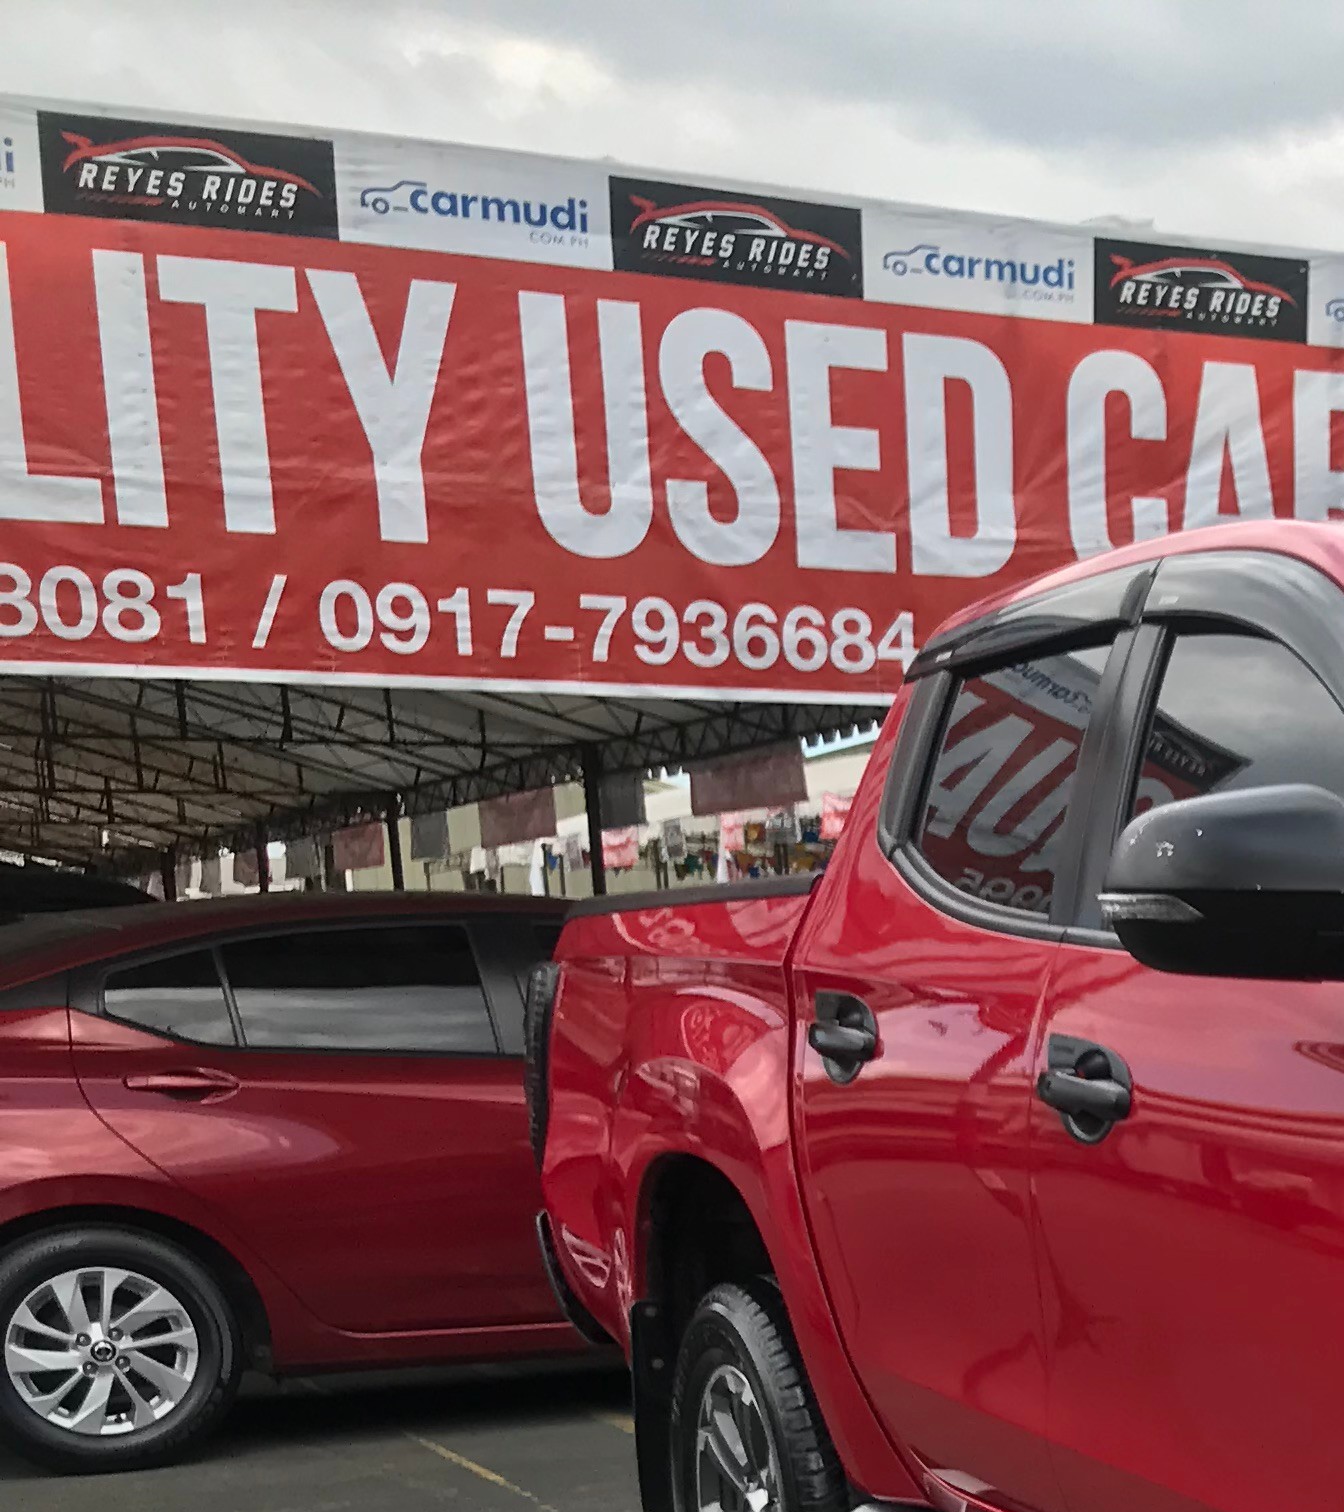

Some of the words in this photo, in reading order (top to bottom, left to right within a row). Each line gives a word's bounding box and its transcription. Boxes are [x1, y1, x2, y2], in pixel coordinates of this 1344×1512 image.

[78, 162, 186, 197] REYES
[202, 174, 299, 209] RIDES
[170, 198, 296, 221] AUTOMART
[409, 187, 589, 234] carmudi
[643, 224, 736, 258] REYES
[748, 237, 831, 271] RIDES
[924, 252, 1075, 291] carmudi
[1119, 280, 1200, 310] REYES
[1209, 290, 1282, 319] RIDES
[517, 289, 1015, 578] USED
[318, 577, 917, 675] 0917-7936684
